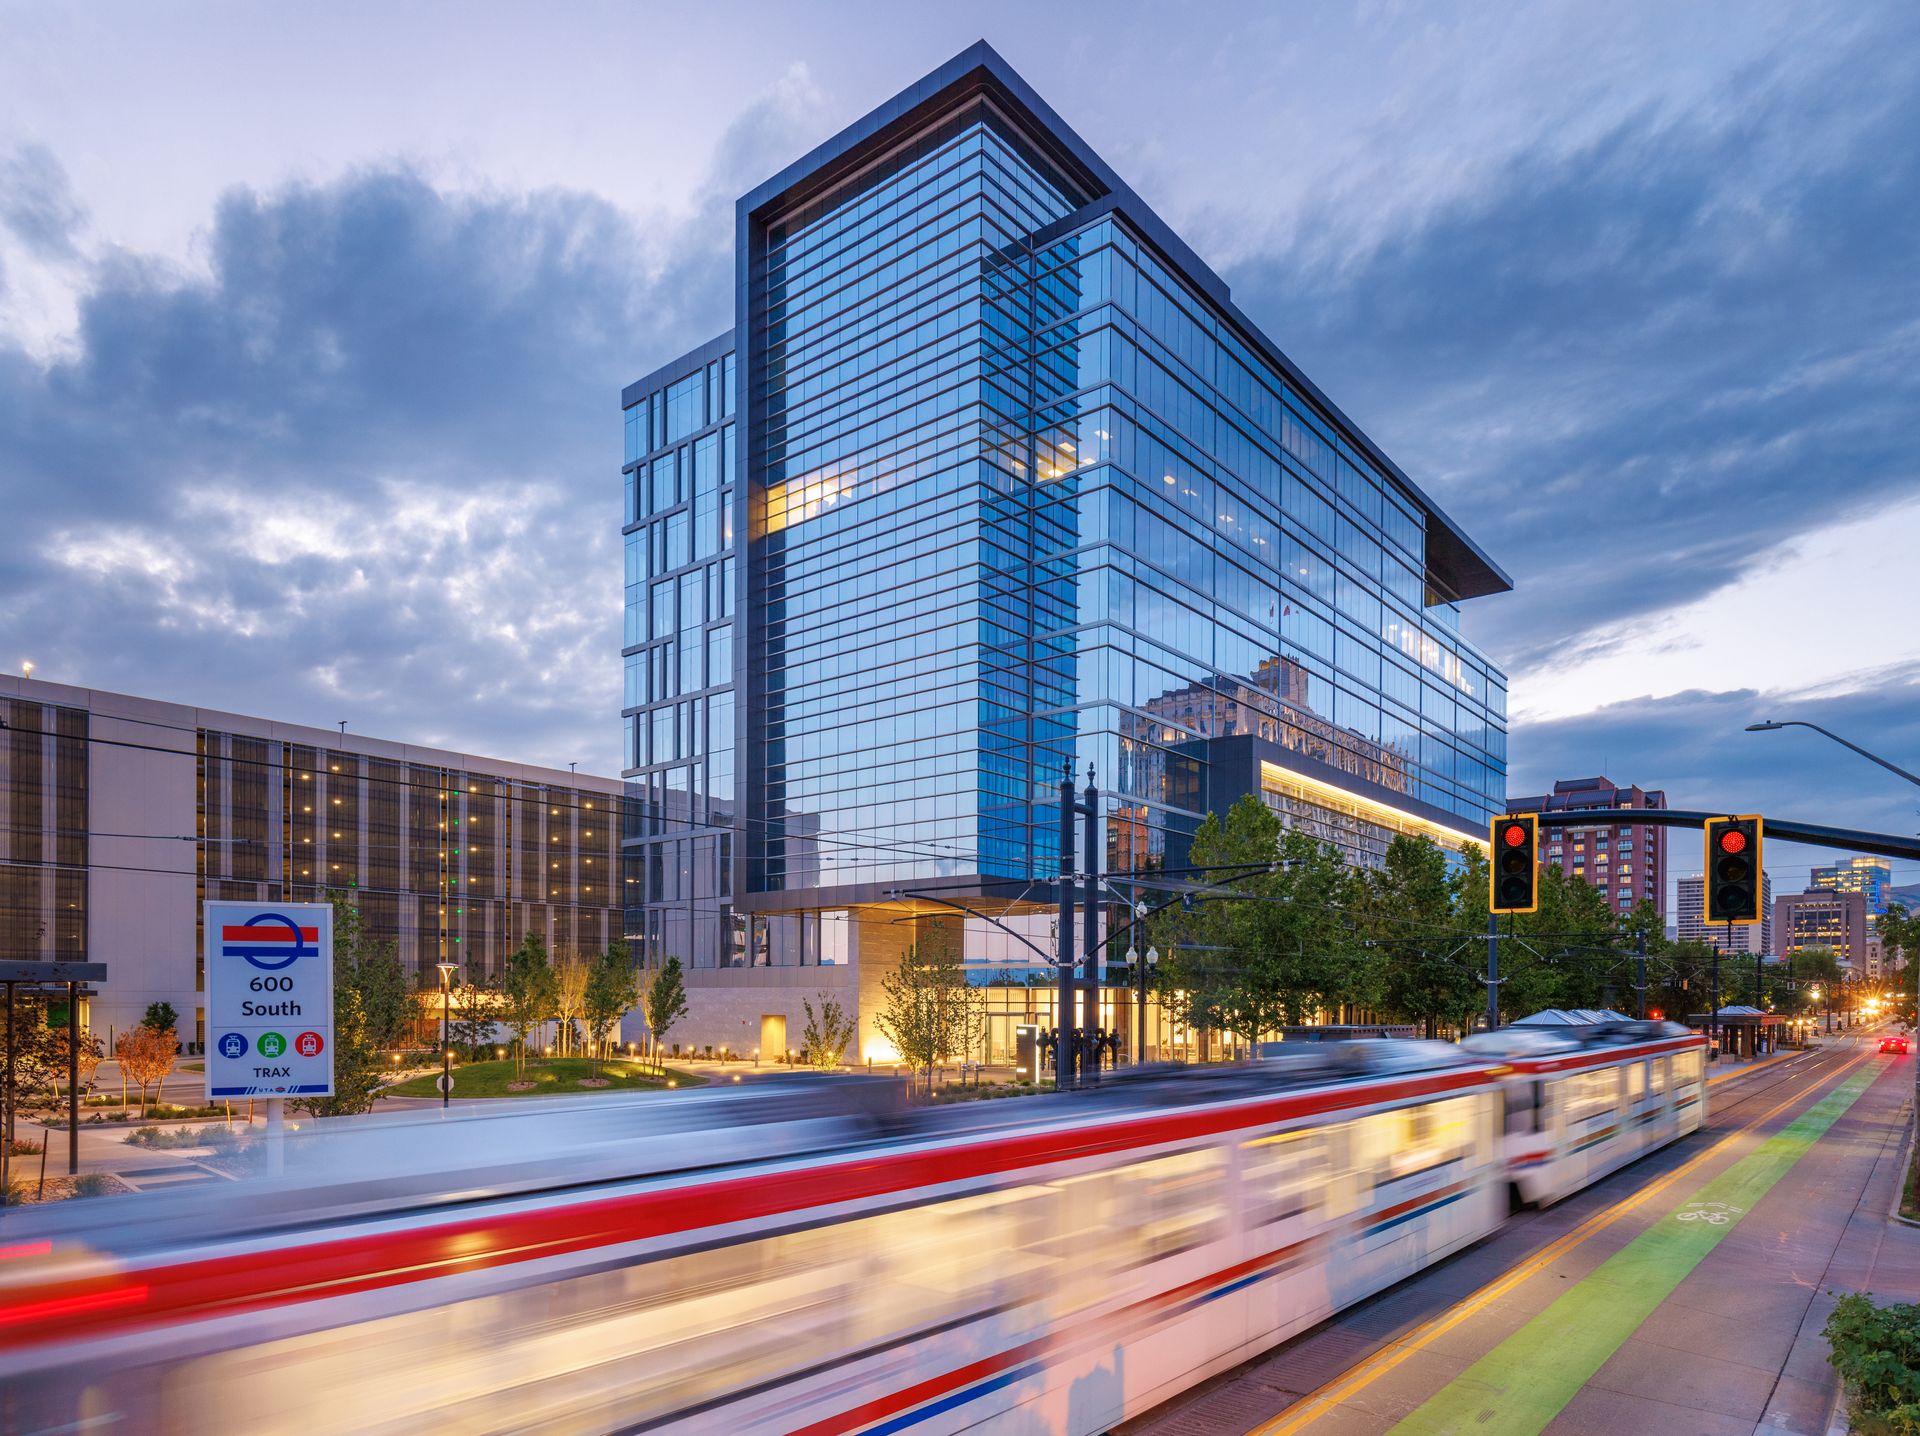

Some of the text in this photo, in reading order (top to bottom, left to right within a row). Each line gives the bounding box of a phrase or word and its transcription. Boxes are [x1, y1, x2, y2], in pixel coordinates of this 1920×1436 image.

[249, 976, 294, 992] 600
[241, 1000, 302, 1017] South
[253, 1067, 291, 1078] TRAX
